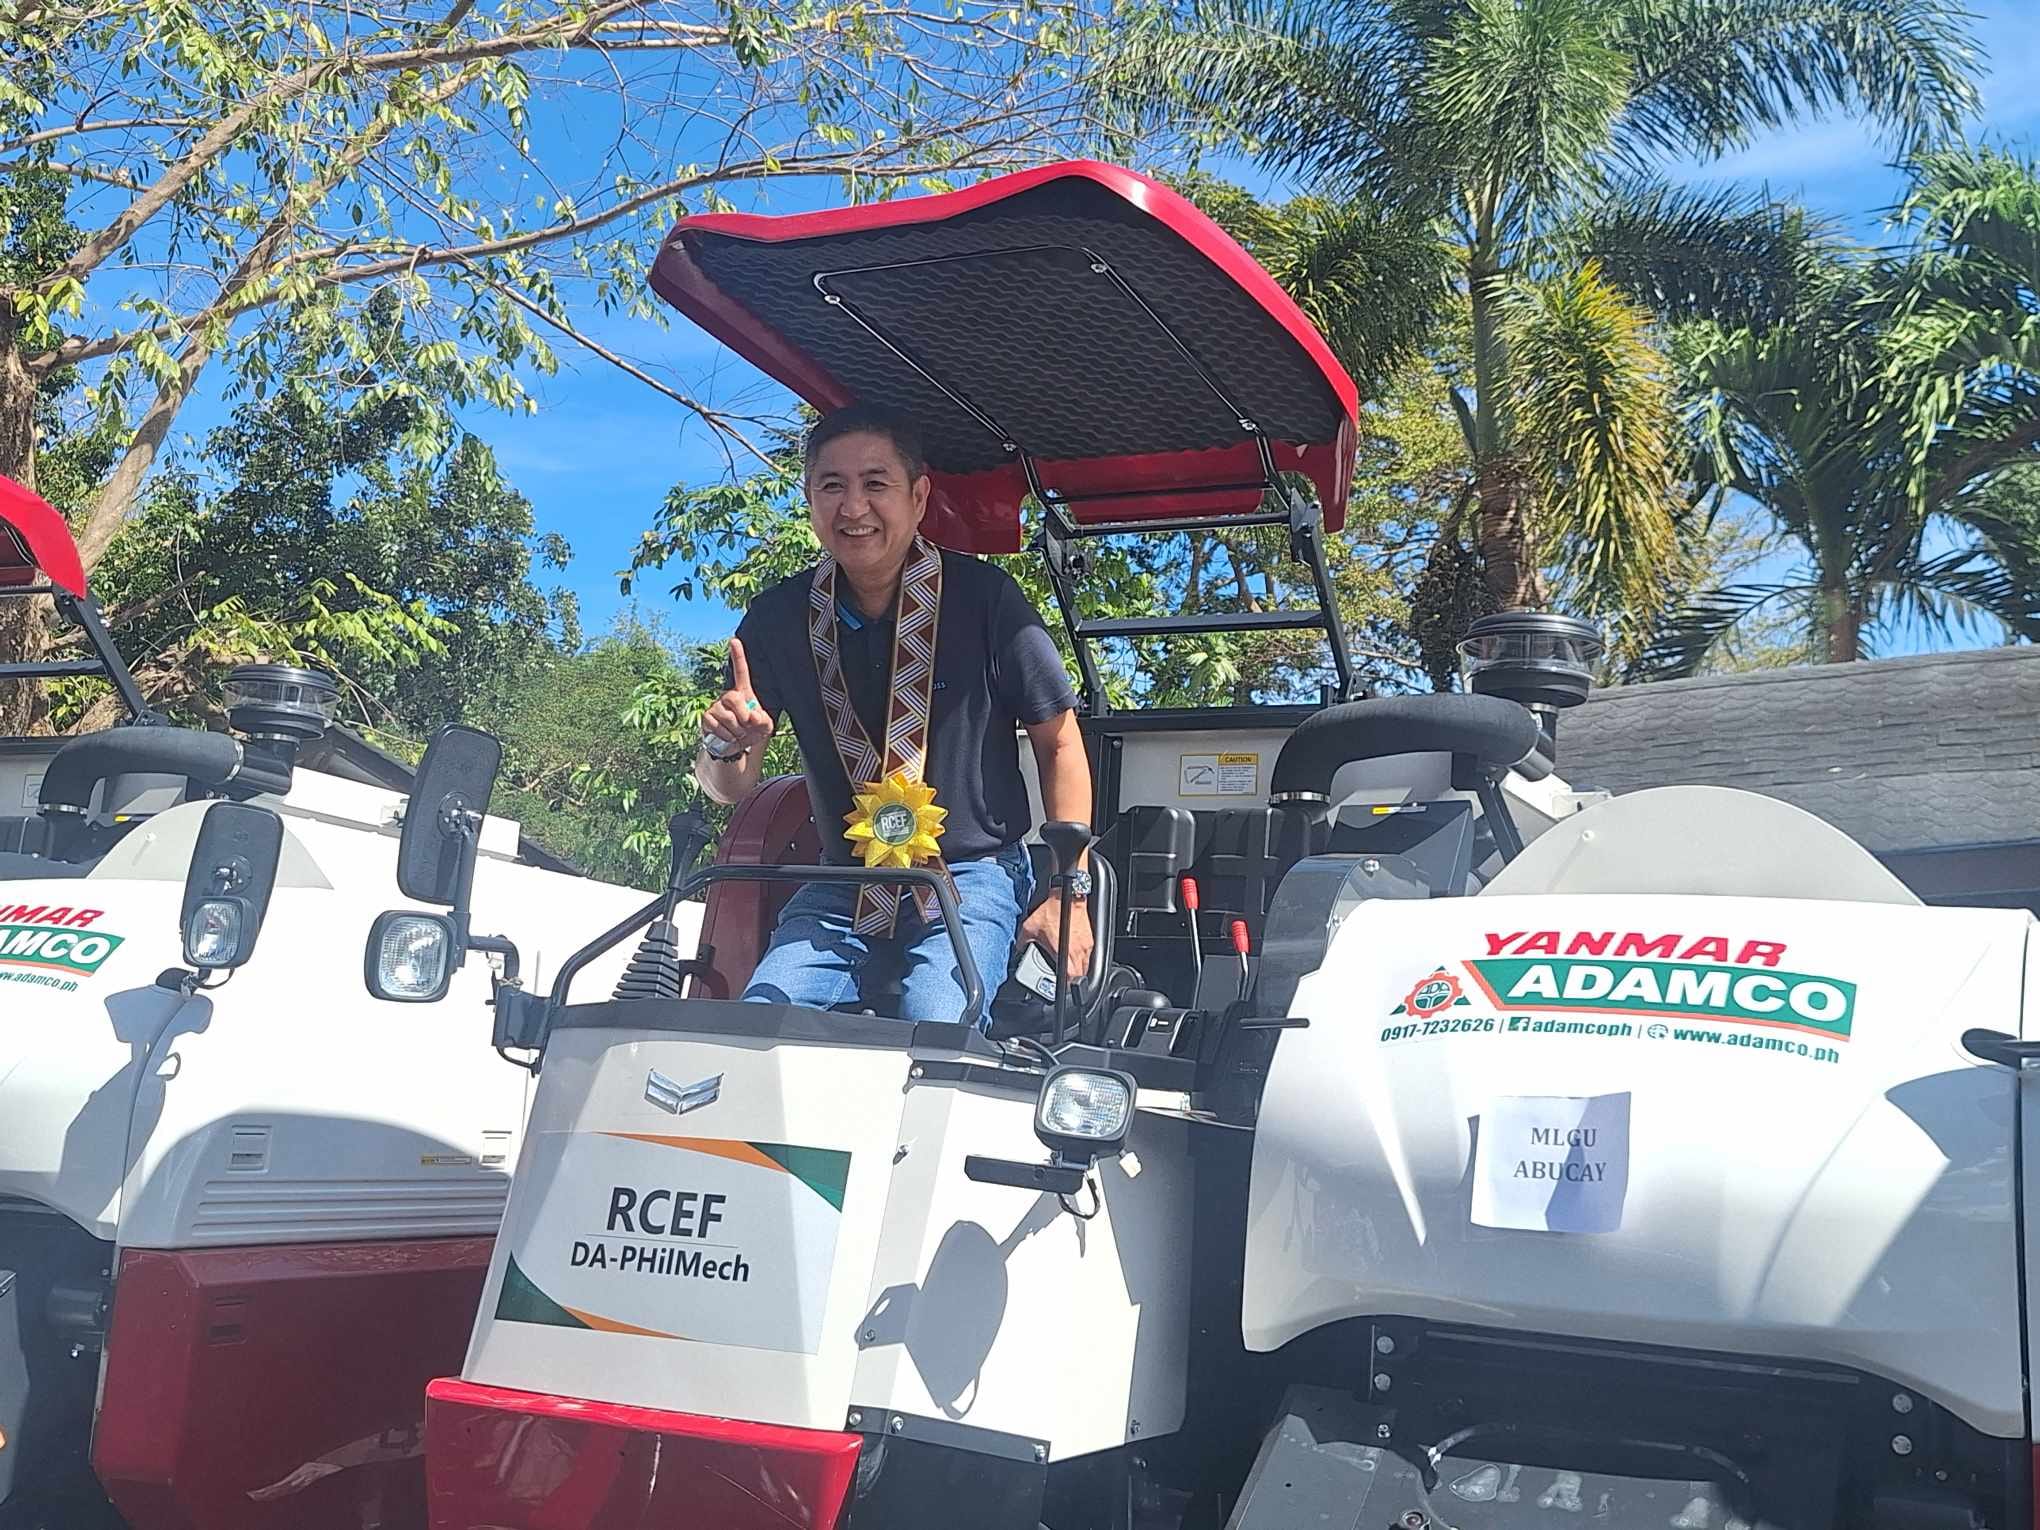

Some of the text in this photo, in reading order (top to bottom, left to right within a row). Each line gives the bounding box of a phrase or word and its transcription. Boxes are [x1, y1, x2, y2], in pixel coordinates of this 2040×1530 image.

[1484, 931, 1787, 967] YANMAR
[1507, 964, 1848, 1022] ADAMCO
[1381, 1018, 1495, 1042] 0917-7232626
[1673, 1027, 1840, 1064] www.adamco.ph
[1531, 1127, 1597, 1147] MLGU
[1513, 1160, 1607, 1182] ABUCAY
[606, 1186, 727, 1239] RCEF
[570, 1241, 750, 1283] DA-PHilMech
